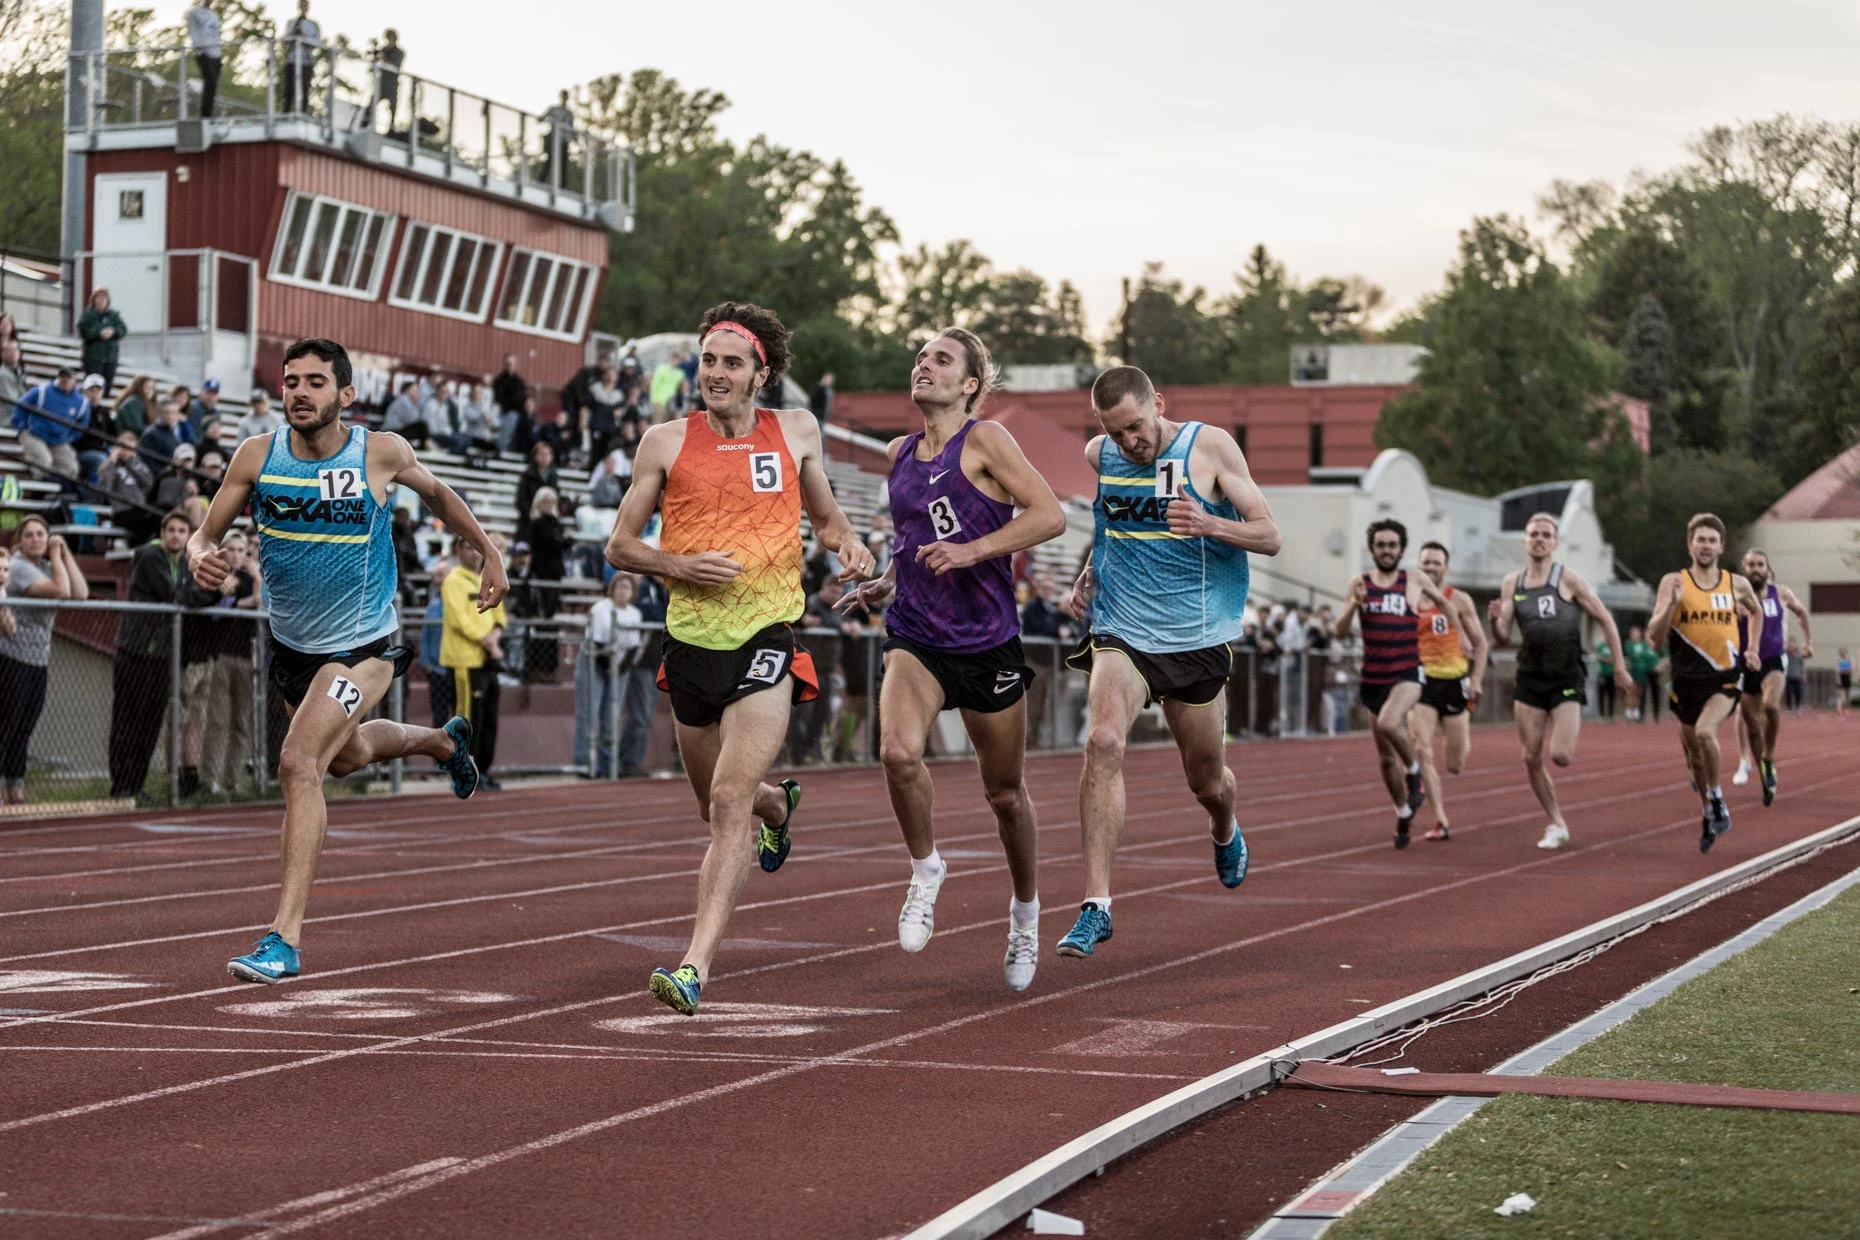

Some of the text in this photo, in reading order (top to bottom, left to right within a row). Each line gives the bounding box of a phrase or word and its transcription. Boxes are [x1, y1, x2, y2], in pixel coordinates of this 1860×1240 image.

[716, 443, 754, 451] saucony
[755, 455, 777, 489] 5
[1160, 462, 1173, 495] 1
[322, 470, 357, 498] 12
[332, 499, 366, 511] ONE
[1102, 495, 1159, 522] OKA
[332, 512, 367, 524] ONE
[932, 502, 954, 534] 3
[1541, 599, 1554, 615] 2
[1713, 595, 1728, 608] 11
[1435, 618, 1446, 633] 8
[1680, 610, 1732, 624] NAPIER
[753, 652, 779, 678] 5
[336, 679, 360, 714] 12
